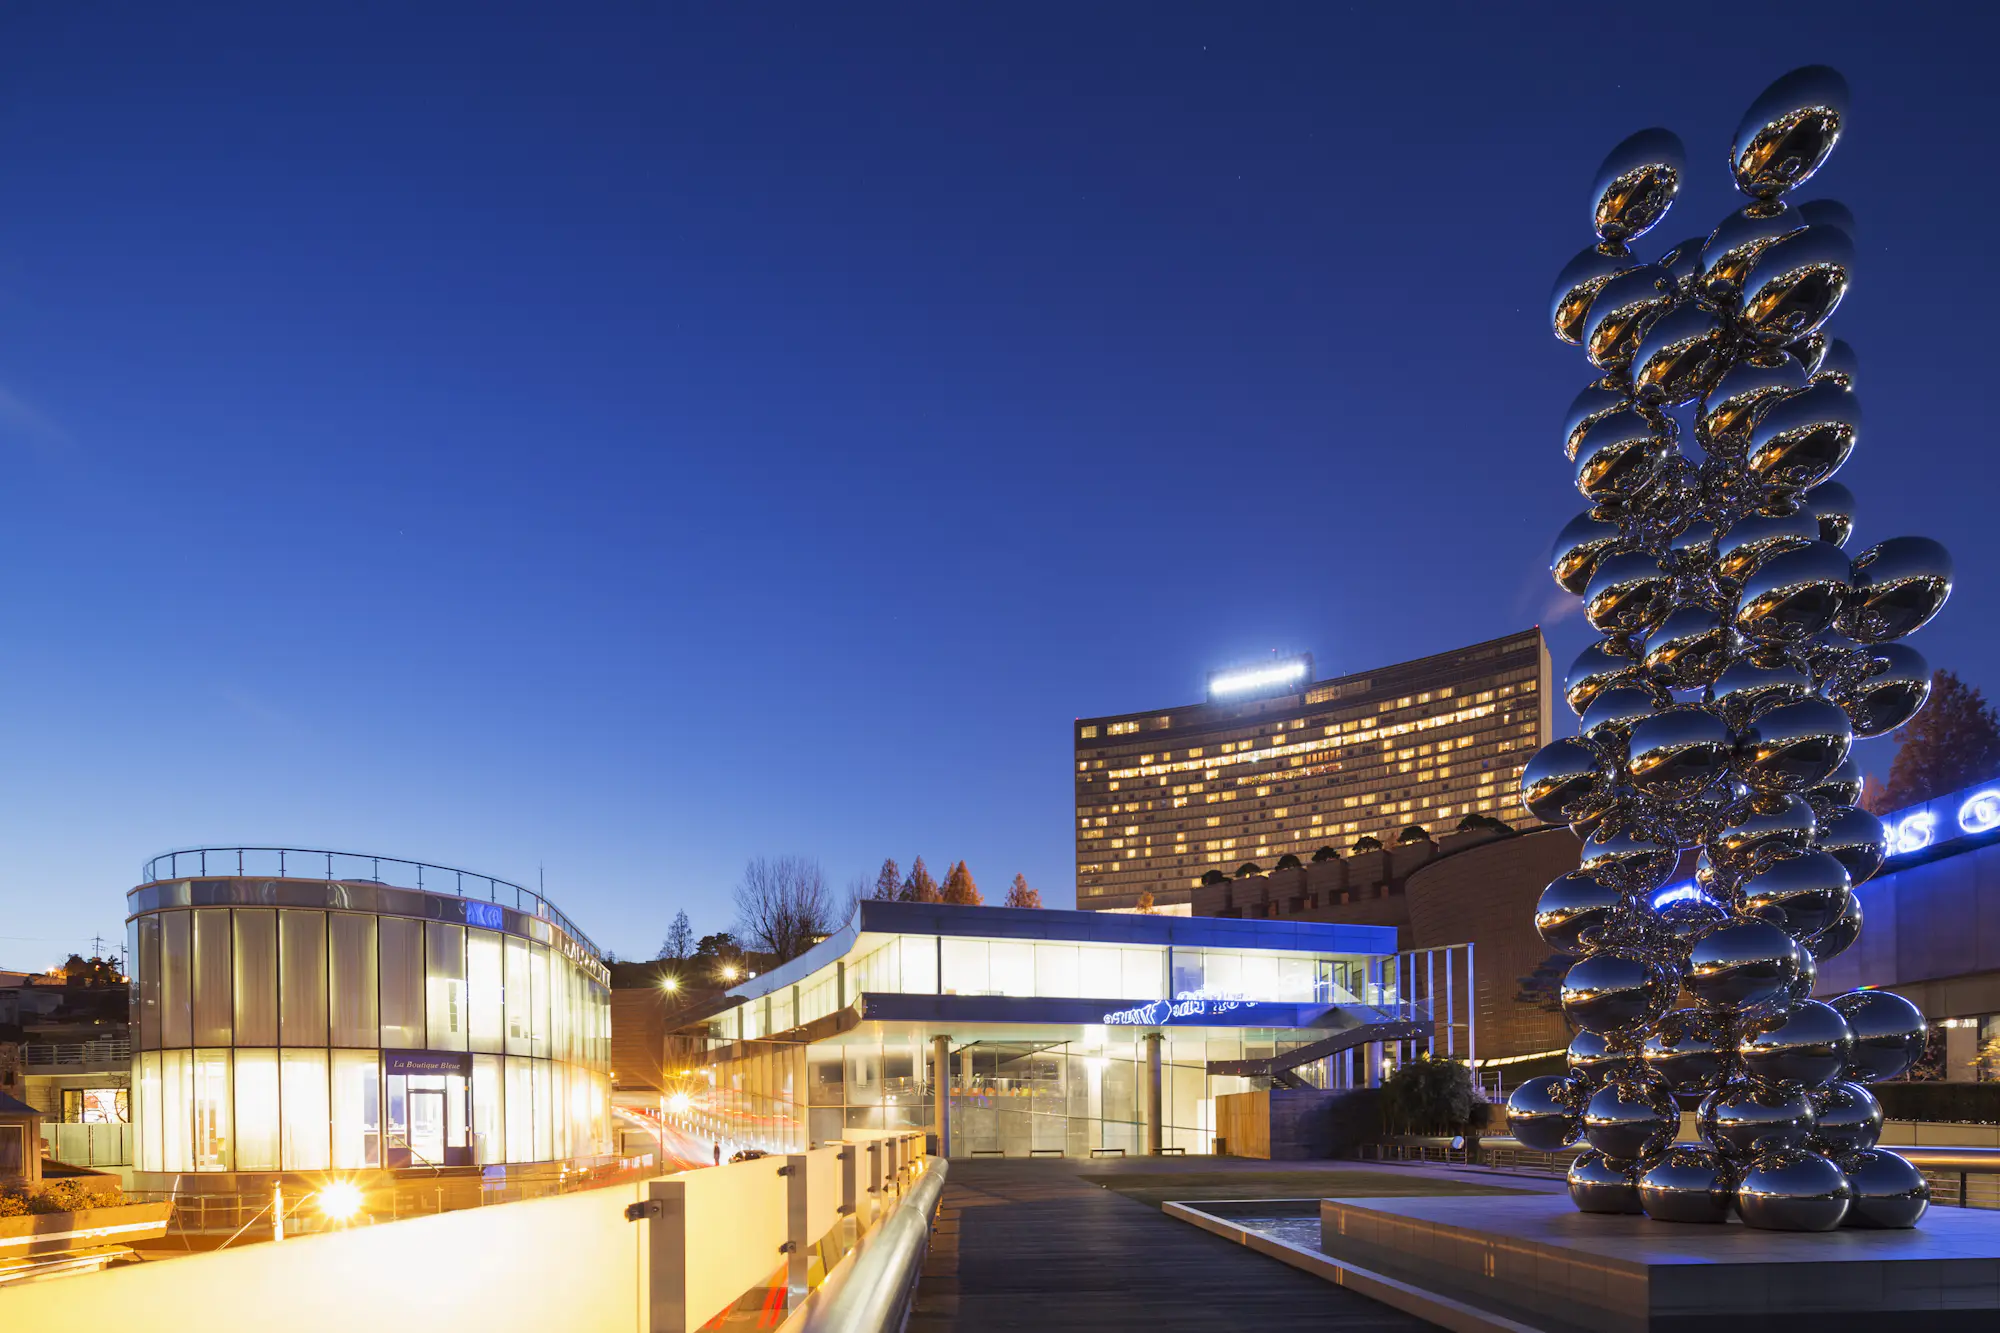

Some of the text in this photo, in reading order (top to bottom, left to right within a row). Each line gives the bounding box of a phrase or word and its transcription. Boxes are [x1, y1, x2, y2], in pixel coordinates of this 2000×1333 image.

[393, 1060, 461, 1070] La Boutique Bleue
